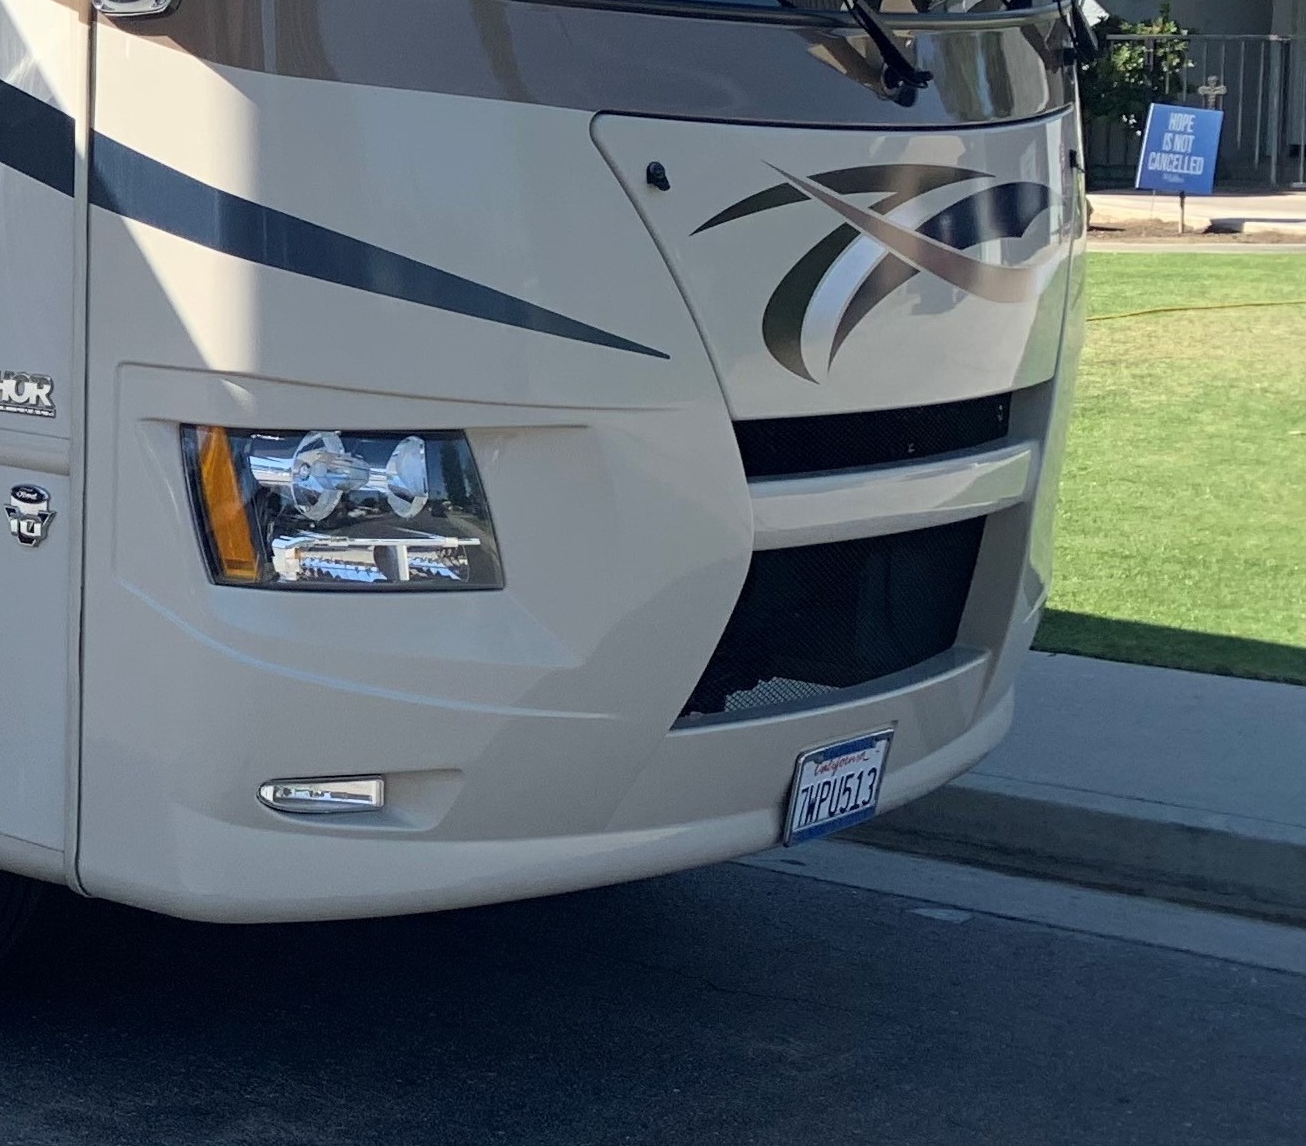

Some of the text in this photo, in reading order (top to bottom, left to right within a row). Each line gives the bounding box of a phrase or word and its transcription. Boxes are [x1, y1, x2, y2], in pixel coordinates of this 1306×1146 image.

[1169, 113, 1196, 132] HOPE
[1163, 133, 1195, 153] IS NOT
[1149, 152, 1204, 175] CANCELLED
[799, 767, 877, 826] 7WPU513
